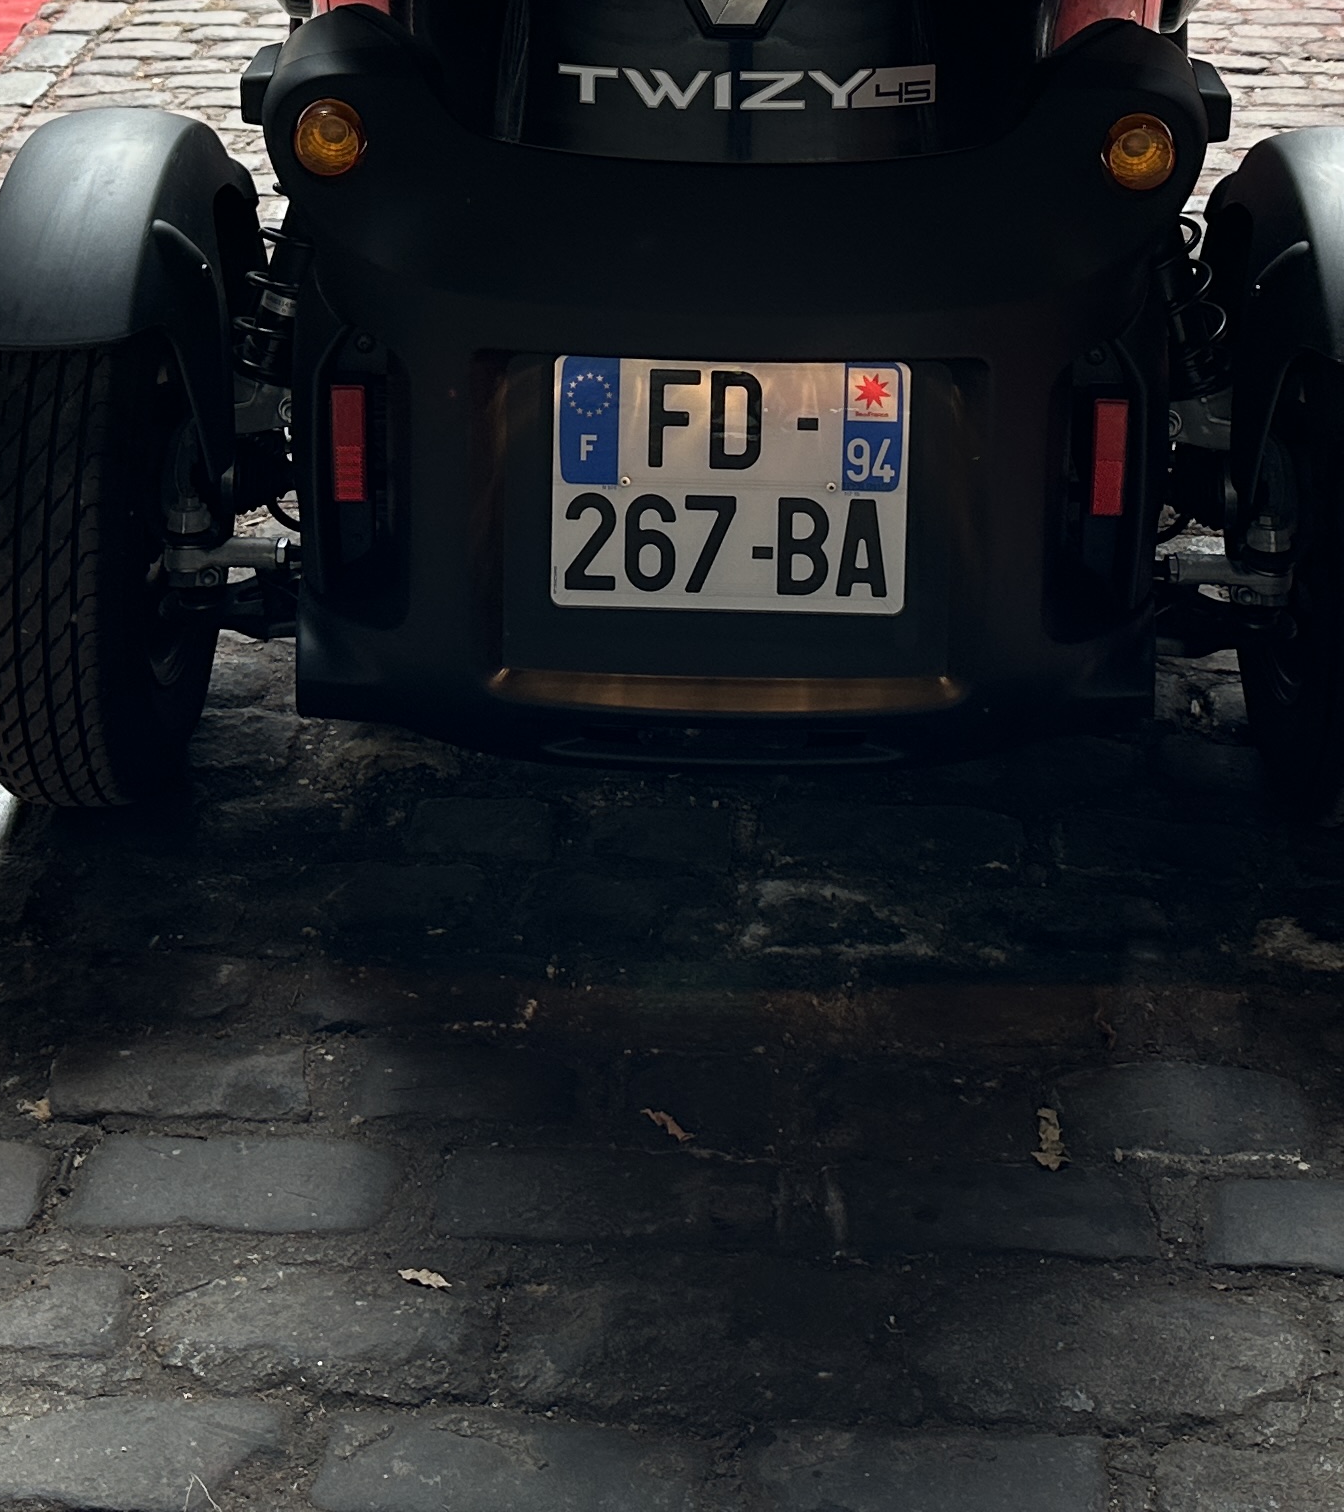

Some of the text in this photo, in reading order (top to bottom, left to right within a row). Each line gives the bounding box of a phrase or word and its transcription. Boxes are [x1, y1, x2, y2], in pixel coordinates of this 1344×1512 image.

[558, 62, 931, 110] TWIZY 45
[580, 434, 597, 461] F
[846, 437, 895, 484] 94
